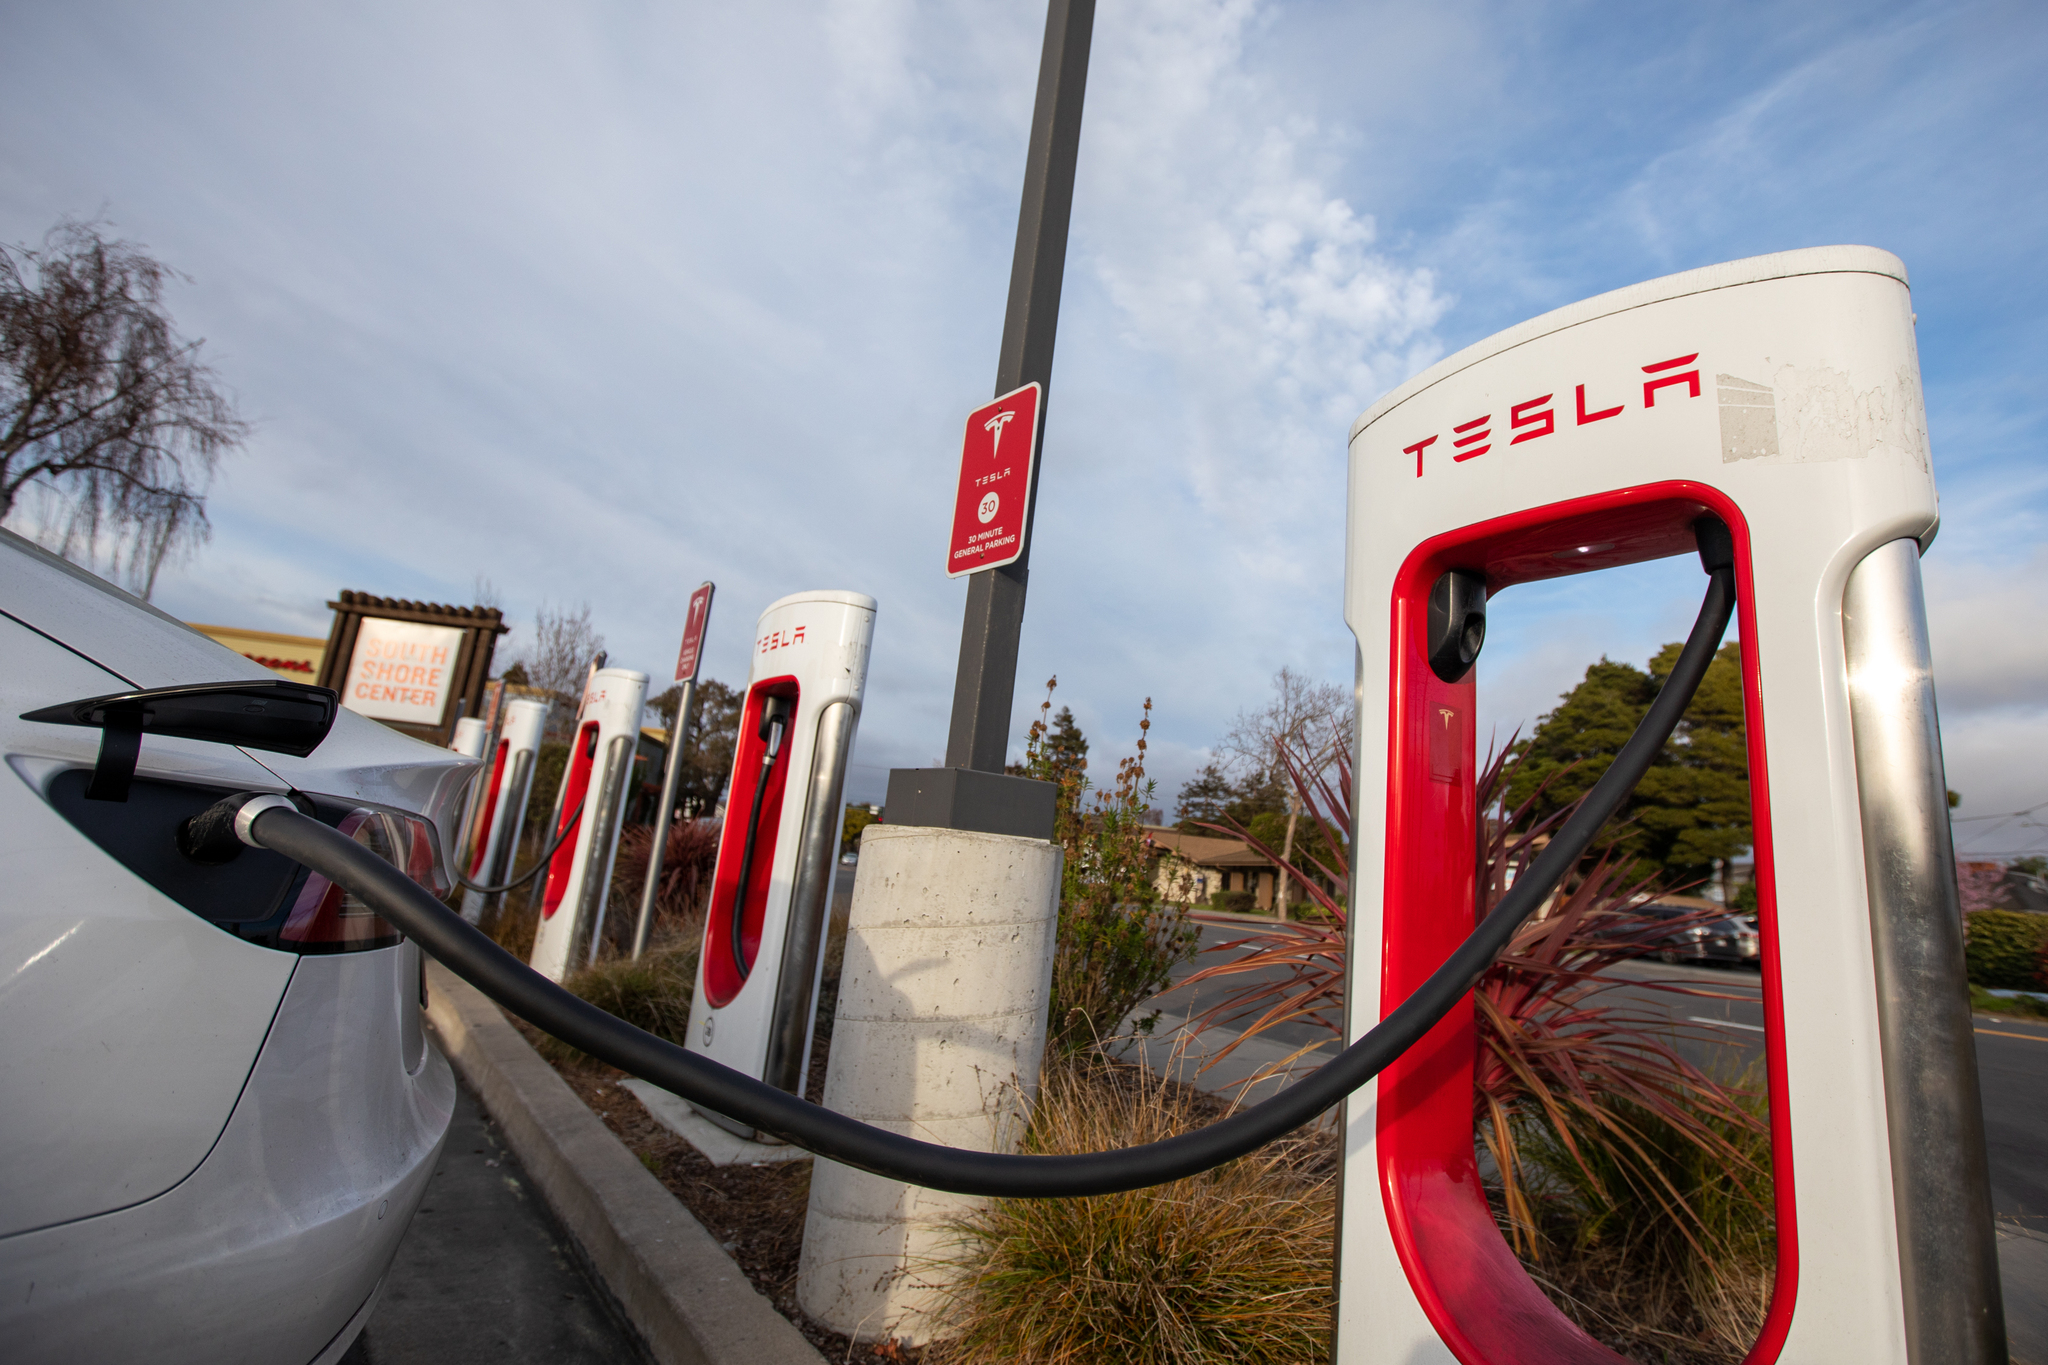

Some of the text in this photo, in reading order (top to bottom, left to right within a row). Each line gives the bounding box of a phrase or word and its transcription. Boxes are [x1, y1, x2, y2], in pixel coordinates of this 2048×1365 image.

[1402, 352, 1701, 479] TESLA
[975, 467, 1011, 487] TESLA
[981, 500, 996, 515] 30
[954, 534, 1015, 559] GENERAL PARKING
[968, 526, 1003, 544] 30 MINUTE
[366, 637, 448, 664] SOUTH
[756, 625, 806, 655] TESLA
[360, 660, 442, 687] SHORE
[354, 682, 436, 707] CENTER
